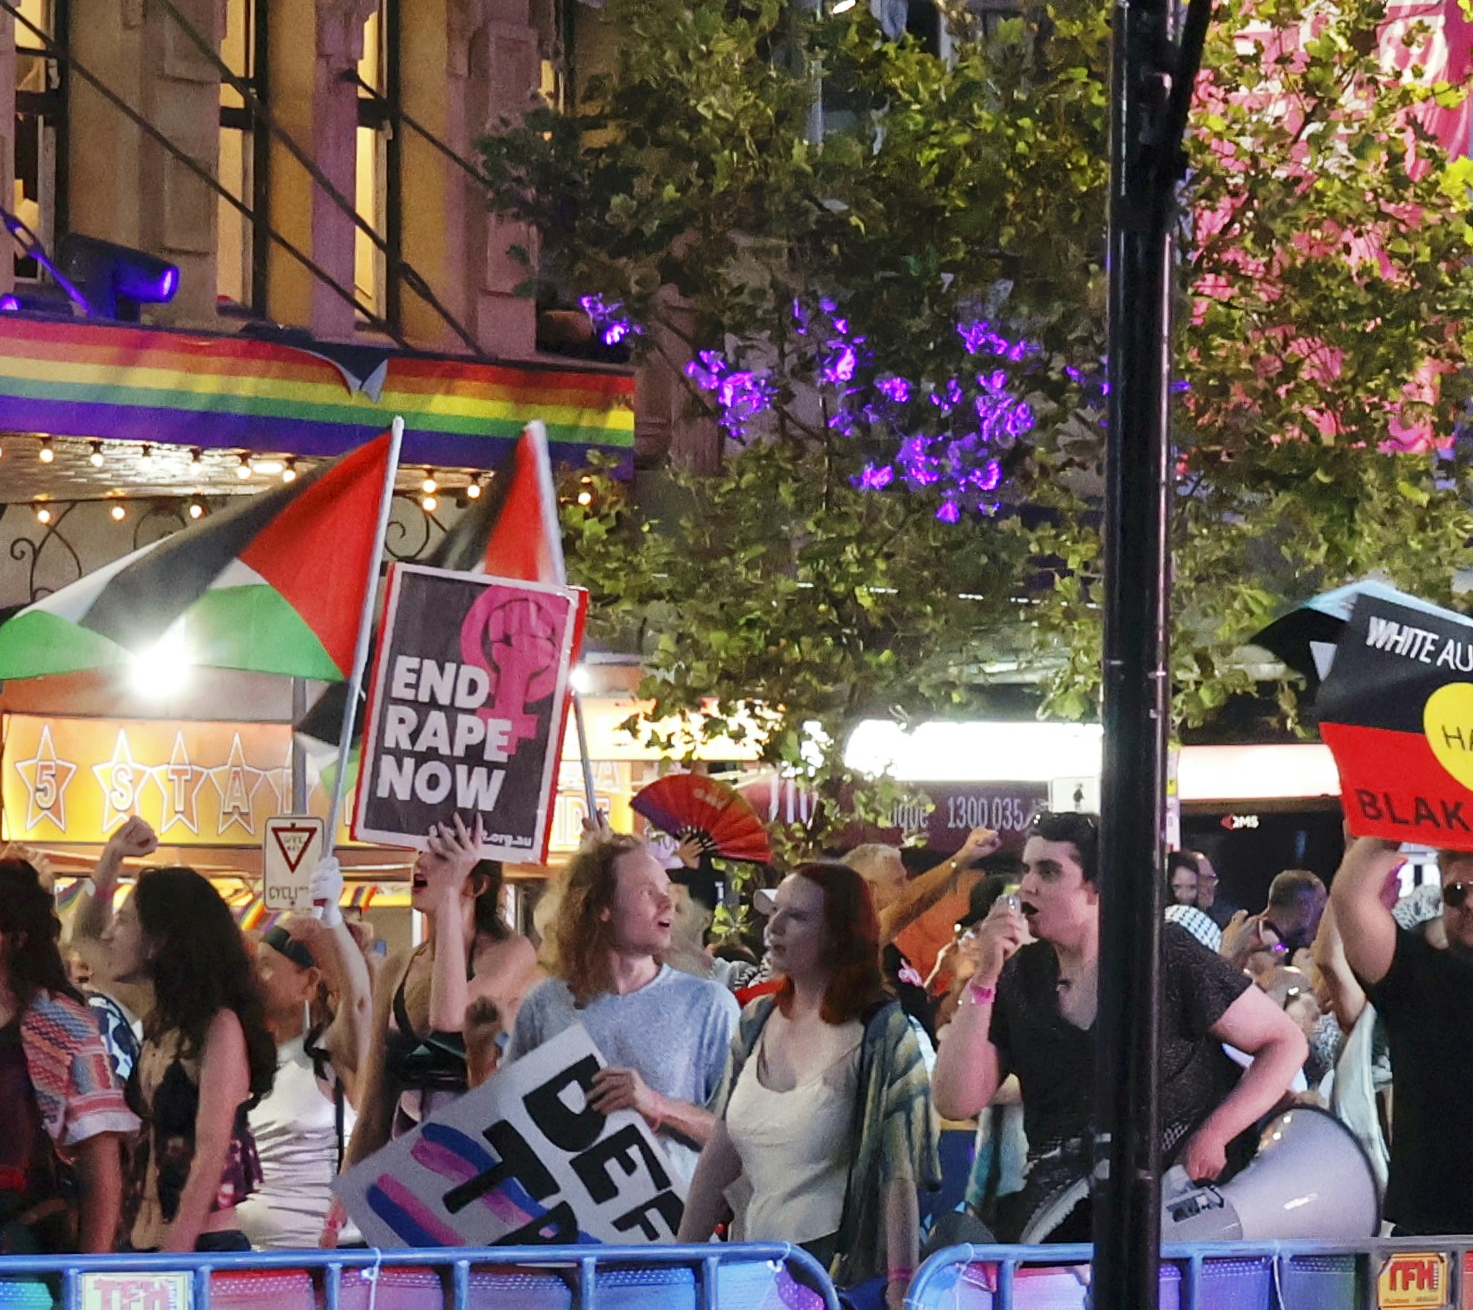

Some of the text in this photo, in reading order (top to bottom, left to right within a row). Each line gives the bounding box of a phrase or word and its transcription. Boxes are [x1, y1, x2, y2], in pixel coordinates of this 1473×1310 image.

[1365, 615, 1440, 665] WHITE
[391, 655, 491, 710] END
[383, 704, 514, 764] RAPE
[34, 760, 57, 809] 5
[375, 754, 507, 812] NOW
[946, 795, 989, 830] 1300
[1354, 788, 1473, 834] BLAK
